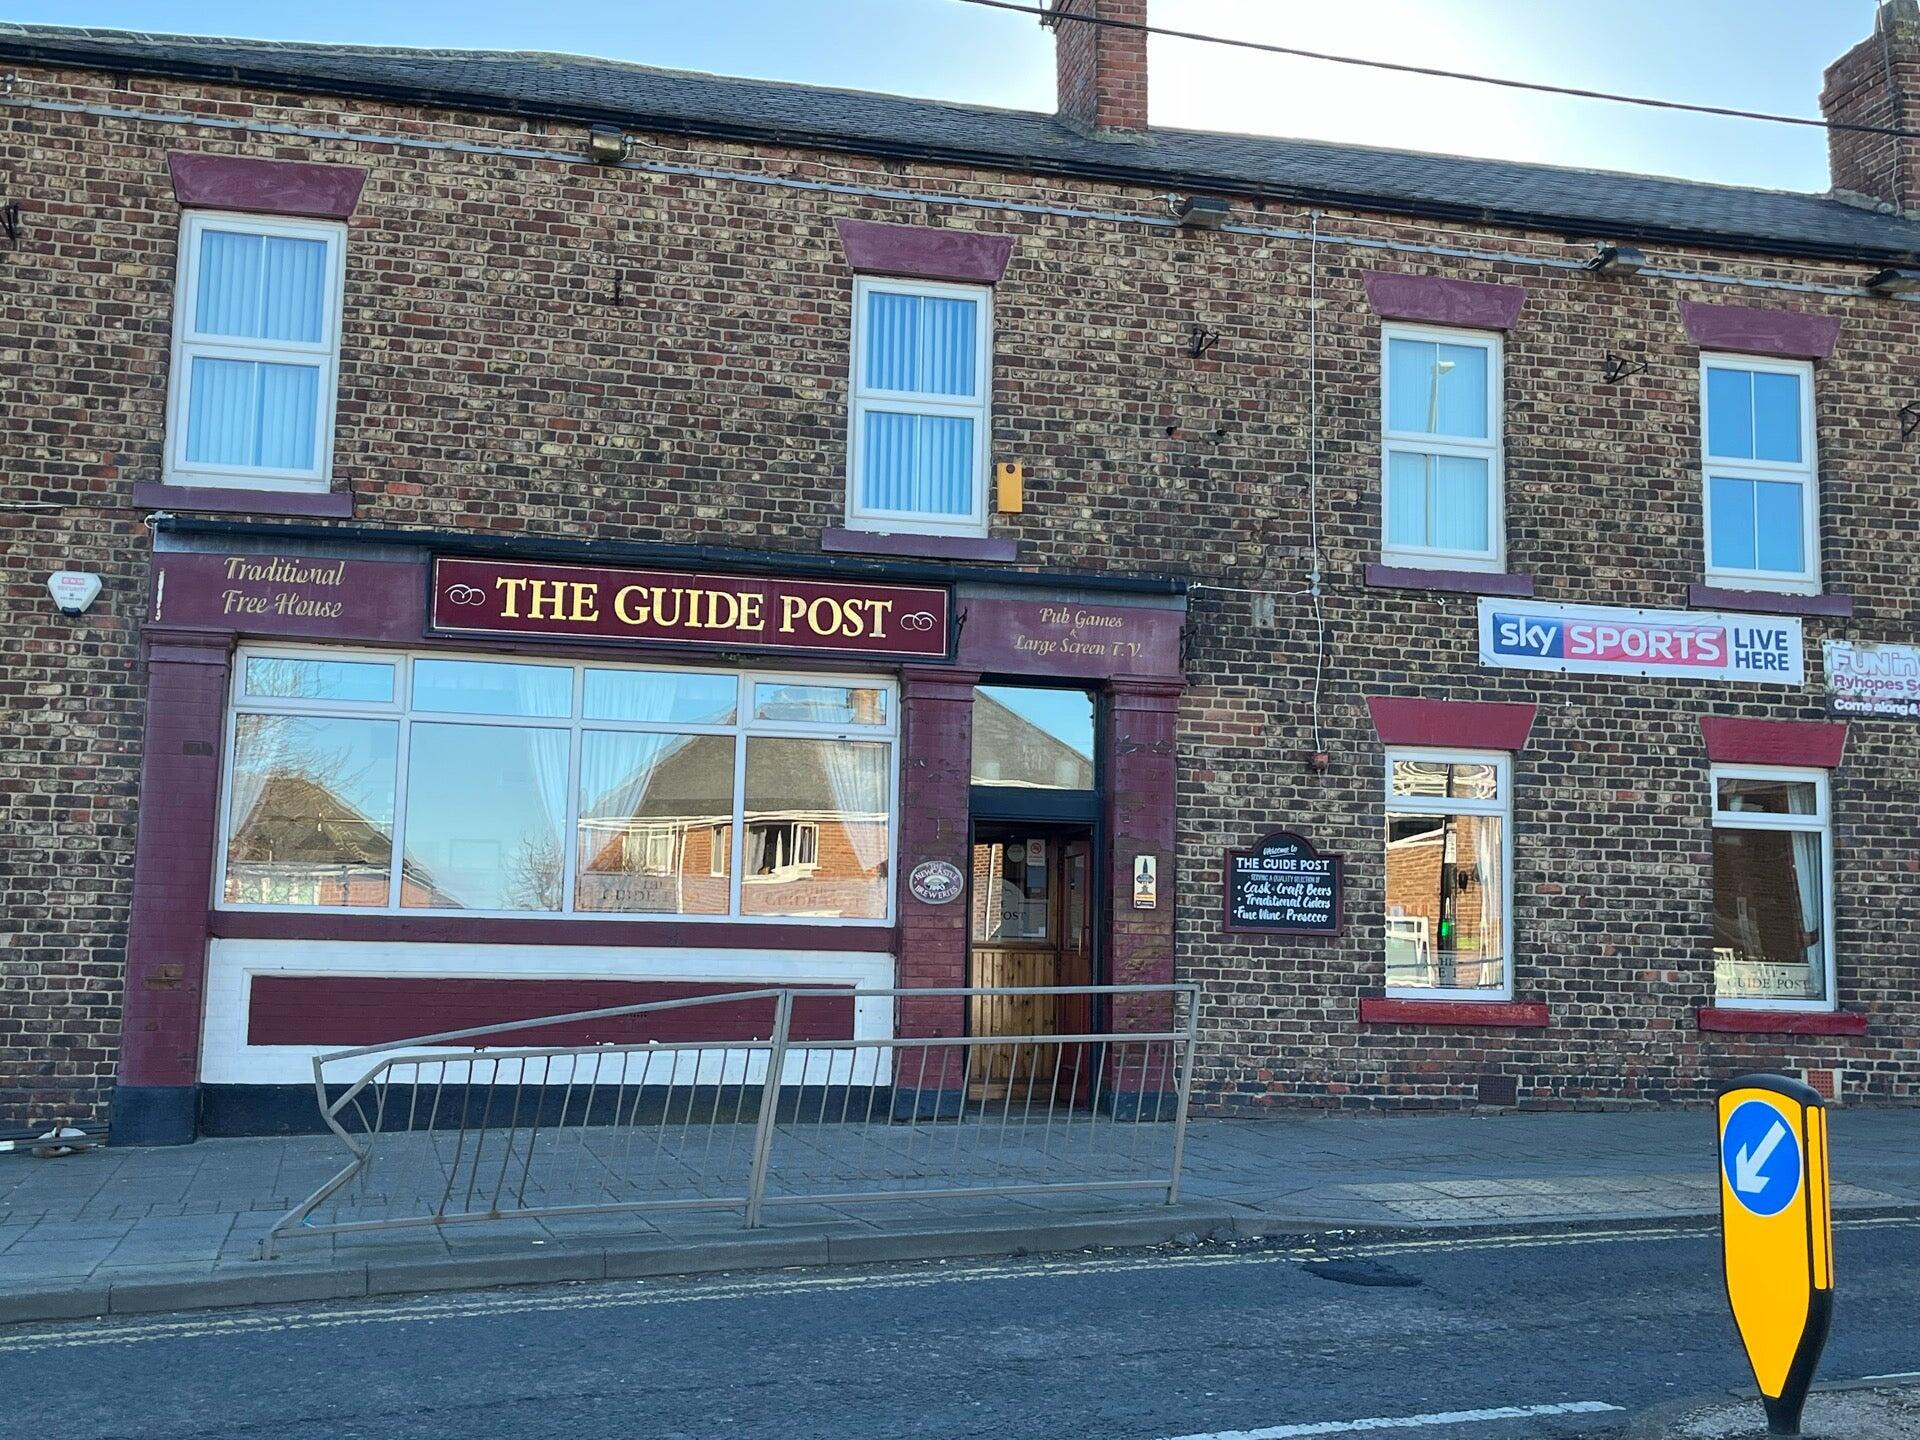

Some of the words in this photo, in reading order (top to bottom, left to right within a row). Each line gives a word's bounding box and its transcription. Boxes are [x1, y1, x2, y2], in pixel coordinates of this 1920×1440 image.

[224, 556, 346, 586] Traditional
[222, 589, 270, 615] Free
[274, 592, 344, 618] House
[496, 576, 599, 622] THE
[614, 585, 765, 631] GUIDE
[779, 594, 892, 639] POST
[1039, 607, 1070, 624] Pub
[1074, 610, 1123, 628] Games
[1014, 634, 1056, 656] Large
[1059, 637, 1106, 656] Screen
[1500, 617, 1557, 656] sky
[1569, 624, 1721, 662] SPORTS
[1734, 627, 1789, 651] LIVE
[1734, 649, 1789, 671] HERE
[1834, 674, 1904, 691] Ryhopes
[1906, 679, 1920, 691] S
[1834, 699, 1873, 711] Come
[1874, 702, 1908, 715] along
[1290, 844, 1298, 853] to
[1236, 857, 1260, 869] THE
[1263, 858, 1297, 870] GUIDE
[1301, 860, 1330, 871] POST
[915, 868, 958, 881] NEWCASTLE
[914, 884, 958, 899] BREWERIES
[1244, 881, 1271, 894] Cask
[1276, 882, 1304, 897] Craft
[1306, 884, 1332, 897] Beers
[1245, 893, 1301, 908] Traditional
[1303, 896, 1331, 909] Ciders
[1237, 906, 1257, 920] Fine
[1258, 908, 1281, 920] Wine
[1286, 908, 1329, 922] Prosecco
[1777, 979, 1811, 990] POST
